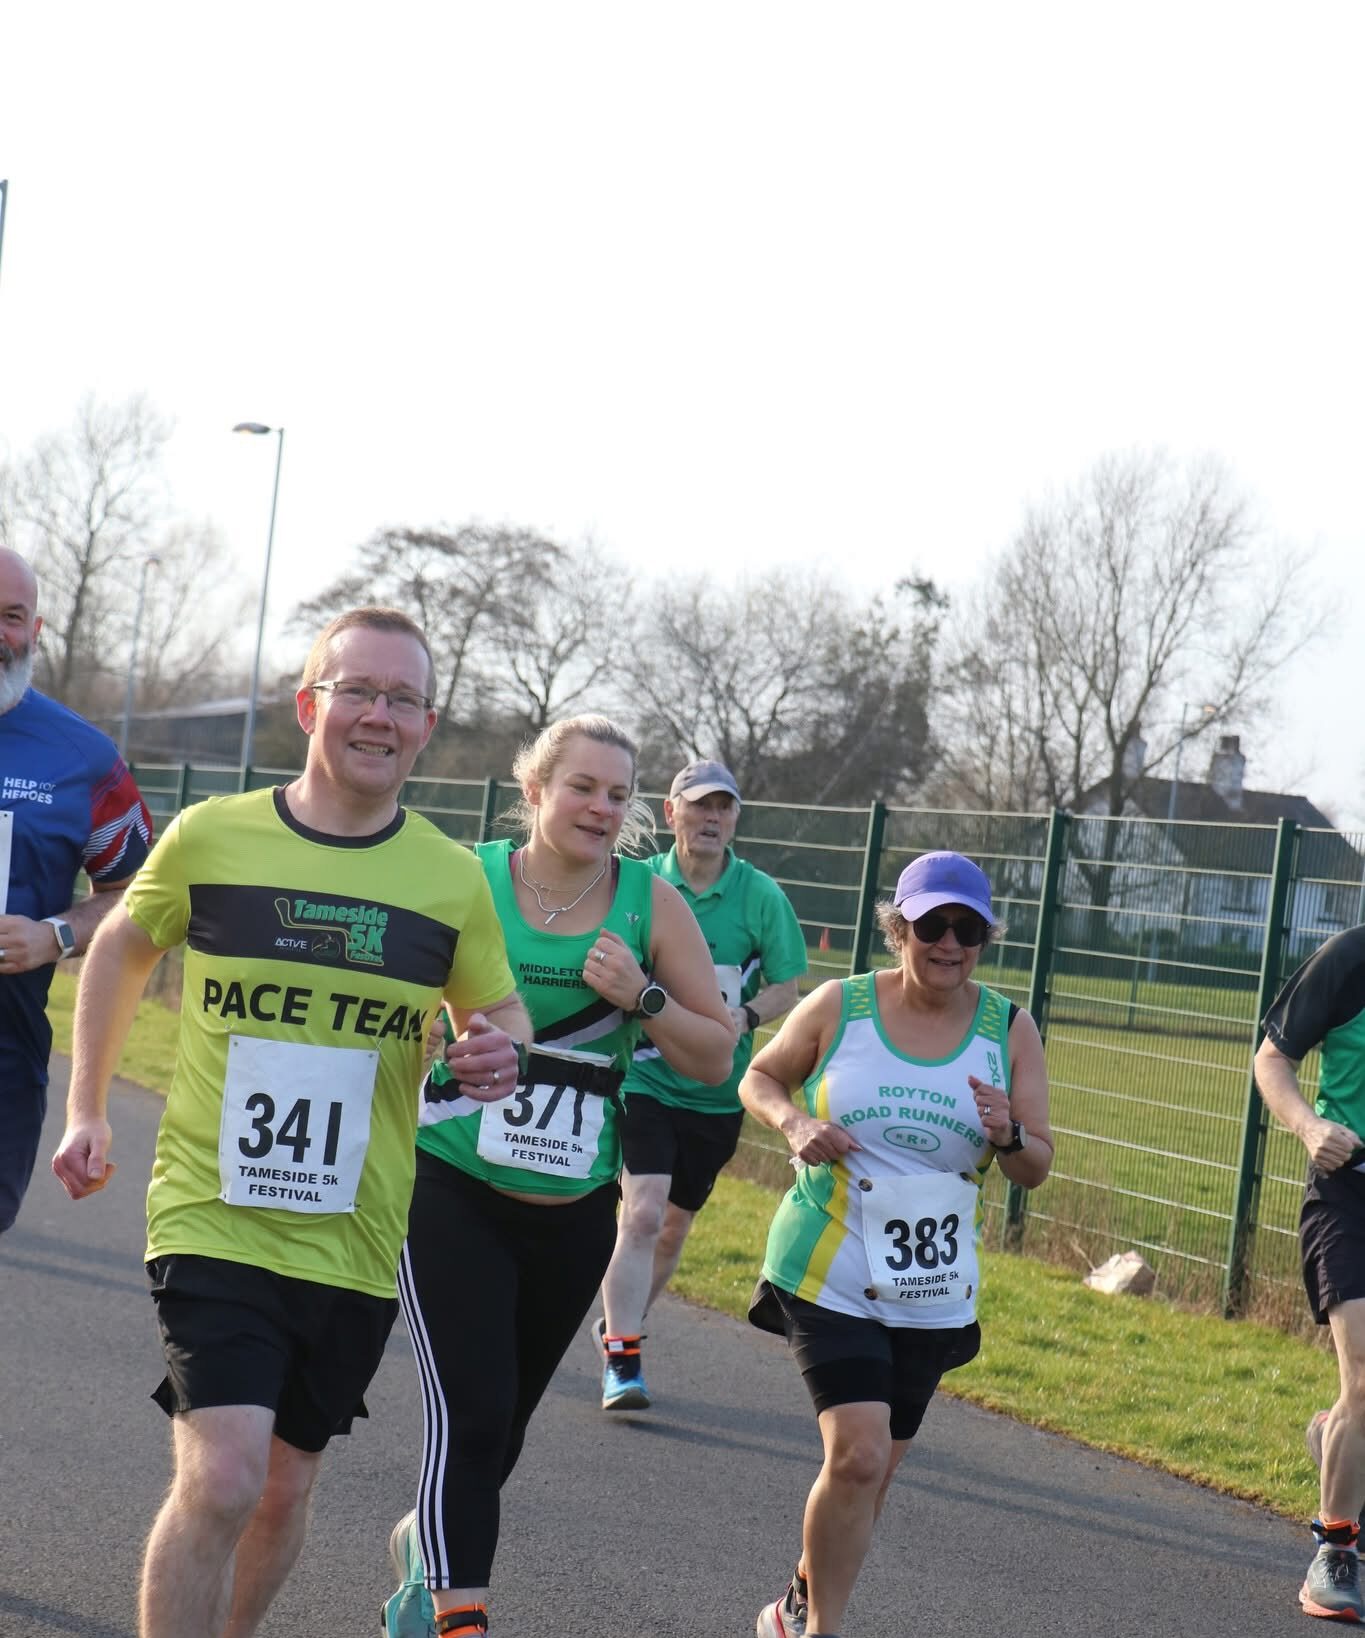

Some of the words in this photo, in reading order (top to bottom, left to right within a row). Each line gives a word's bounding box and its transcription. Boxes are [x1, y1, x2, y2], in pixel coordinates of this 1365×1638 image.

[4, 777, 37, 790] HELP
[2, 789, 53, 804] HEROES
[294, 899, 388, 927] Tameside
[347, 924, 387, 953] 5K
[519, 963, 583, 977] MIDDLETO
[523, 975, 588, 989] HARRIERS
[203, 978, 313, 1026] PACE
[878, 1086, 957, 1109] ROYTON
[503, 1083, 586, 1136] 371
[238, 1092, 343, 1166] 341
[840, 1106, 892, 1127] ROAD
[899, 1107, 985, 1148] RUNNERS
[503, 1132, 568, 1151] TAMESIDE
[511, 1148, 571, 1167] FESTIVAL
[238, 1165, 318, 1185] TAMESIDE
[322, 1174, 339, 1186] 5k
[248, 1184, 322, 1202] FESTIVAL
[884, 1213, 959, 1272] 383
[892, 1273, 947, 1287] TAMESIDE
[899, 1287, 950, 1299] FESTIVAL
